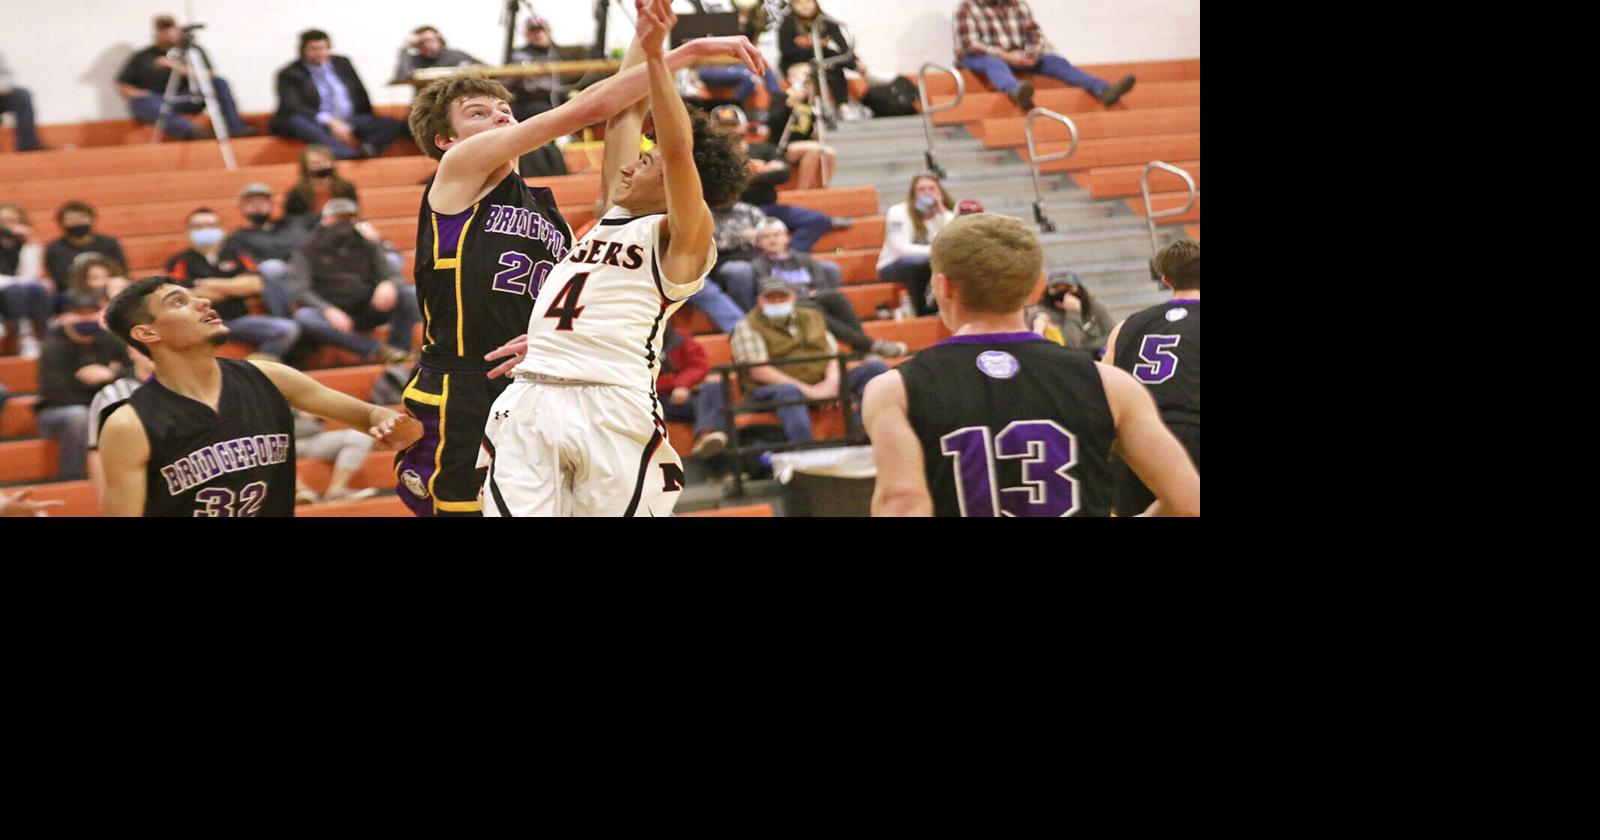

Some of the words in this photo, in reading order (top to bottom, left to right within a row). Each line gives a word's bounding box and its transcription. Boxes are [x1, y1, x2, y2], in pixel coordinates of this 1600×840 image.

[492, 251, 555, 301] 20
[569, 239, 644, 270] GERS
[543, 272, 591, 331] 4
[1133, 334, 1180, 384] 5
[160, 434, 289, 496] BRIDGEPORT
[940, 419, 1080, 517] 13
[193, 481, 267, 517] 32
